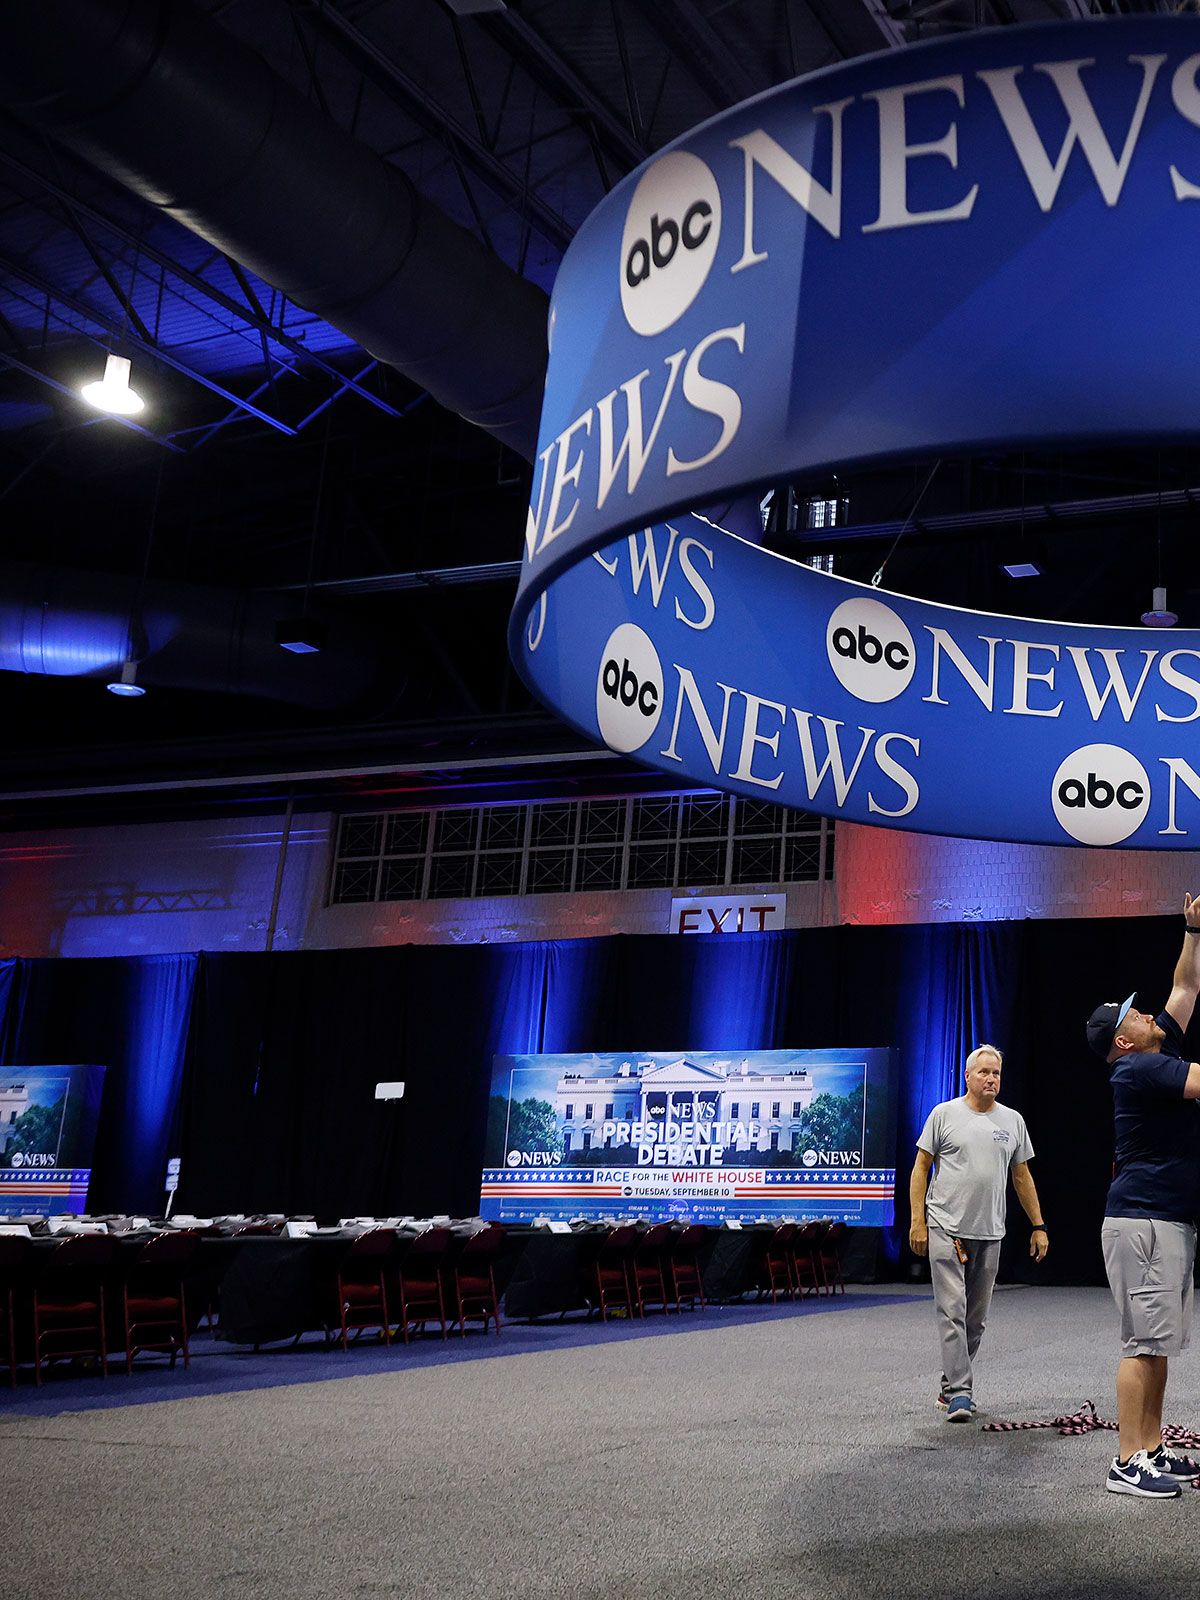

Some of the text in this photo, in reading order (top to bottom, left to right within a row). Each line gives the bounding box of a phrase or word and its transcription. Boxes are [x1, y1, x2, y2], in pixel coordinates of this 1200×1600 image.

[626, 197, 713, 288] abc
[831, 625, 910, 671] abc
[602, 658, 922, 818] abc NEWS
[1058, 772, 1145, 810] abc
[679, 906, 776, 934] EXIT
[651, 1102, 716, 1118] abc NEWS
[603, 1121, 761, 1143] PRESIDENTIAL
[23, 1152, 56, 1166] NEWS
[521, 1151, 562, 1165] NEWS
[638, 1144, 725, 1166] DEBATE
[818, 1151, 861, 1165] NEWS
[596, 1171, 762, 1183] RACE FOR THE WHITE HOUSE
[635, 1187, 671, 1197] TUESDAY,
[672, 1187, 719, 1196] SEPTEMBER
[721, 1187, 730, 1196] 10
